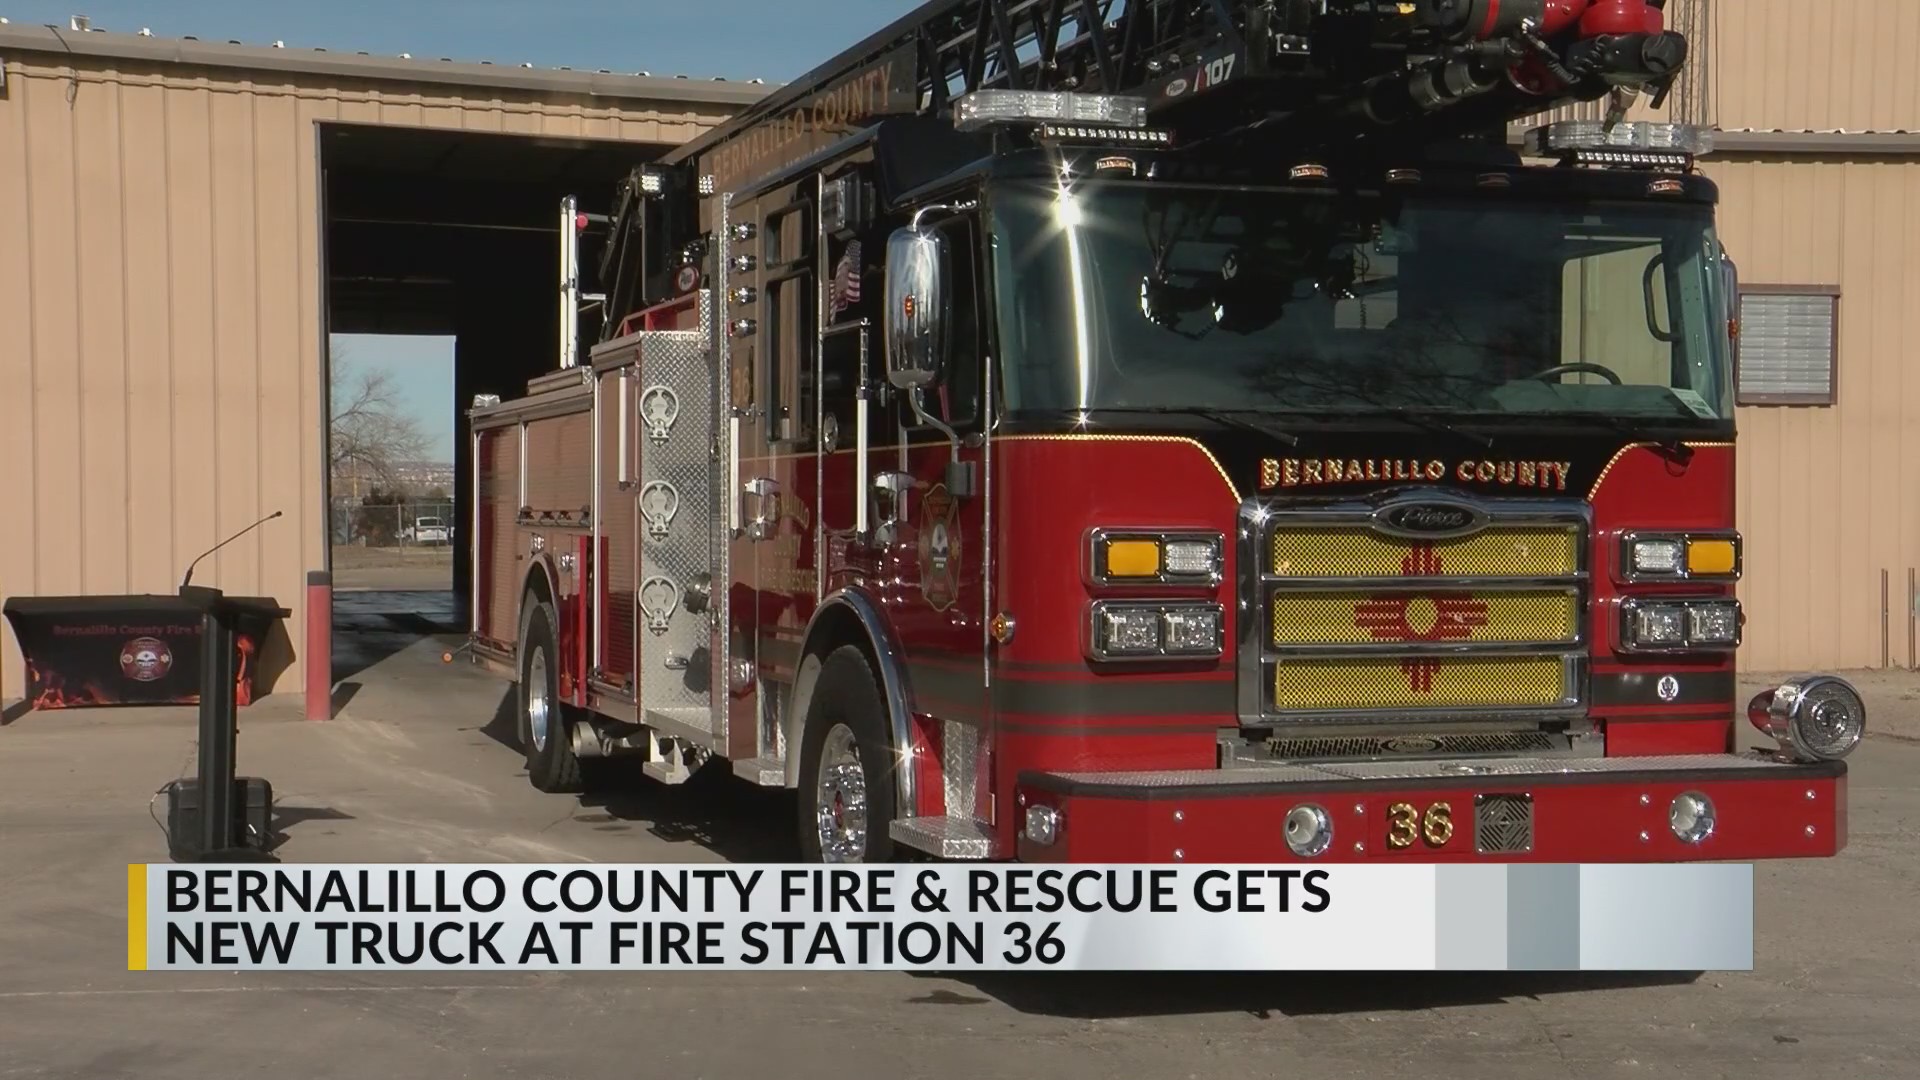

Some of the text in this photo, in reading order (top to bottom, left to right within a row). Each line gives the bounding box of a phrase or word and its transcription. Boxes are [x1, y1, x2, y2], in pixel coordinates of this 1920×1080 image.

[1204, 53, 1236, 87] 107
[712, 108, 805, 187] BERNALILLO
[812, 61, 893, 130] COUNTY
[1260, 457, 1571, 490] BERNALILLO COUNTY
[53, 624, 117, 636] Bernalillo
[119, 624, 163, 638] County
[167, 624, 192, 636] Fire
[1386, 802, 1454, 849] 36
